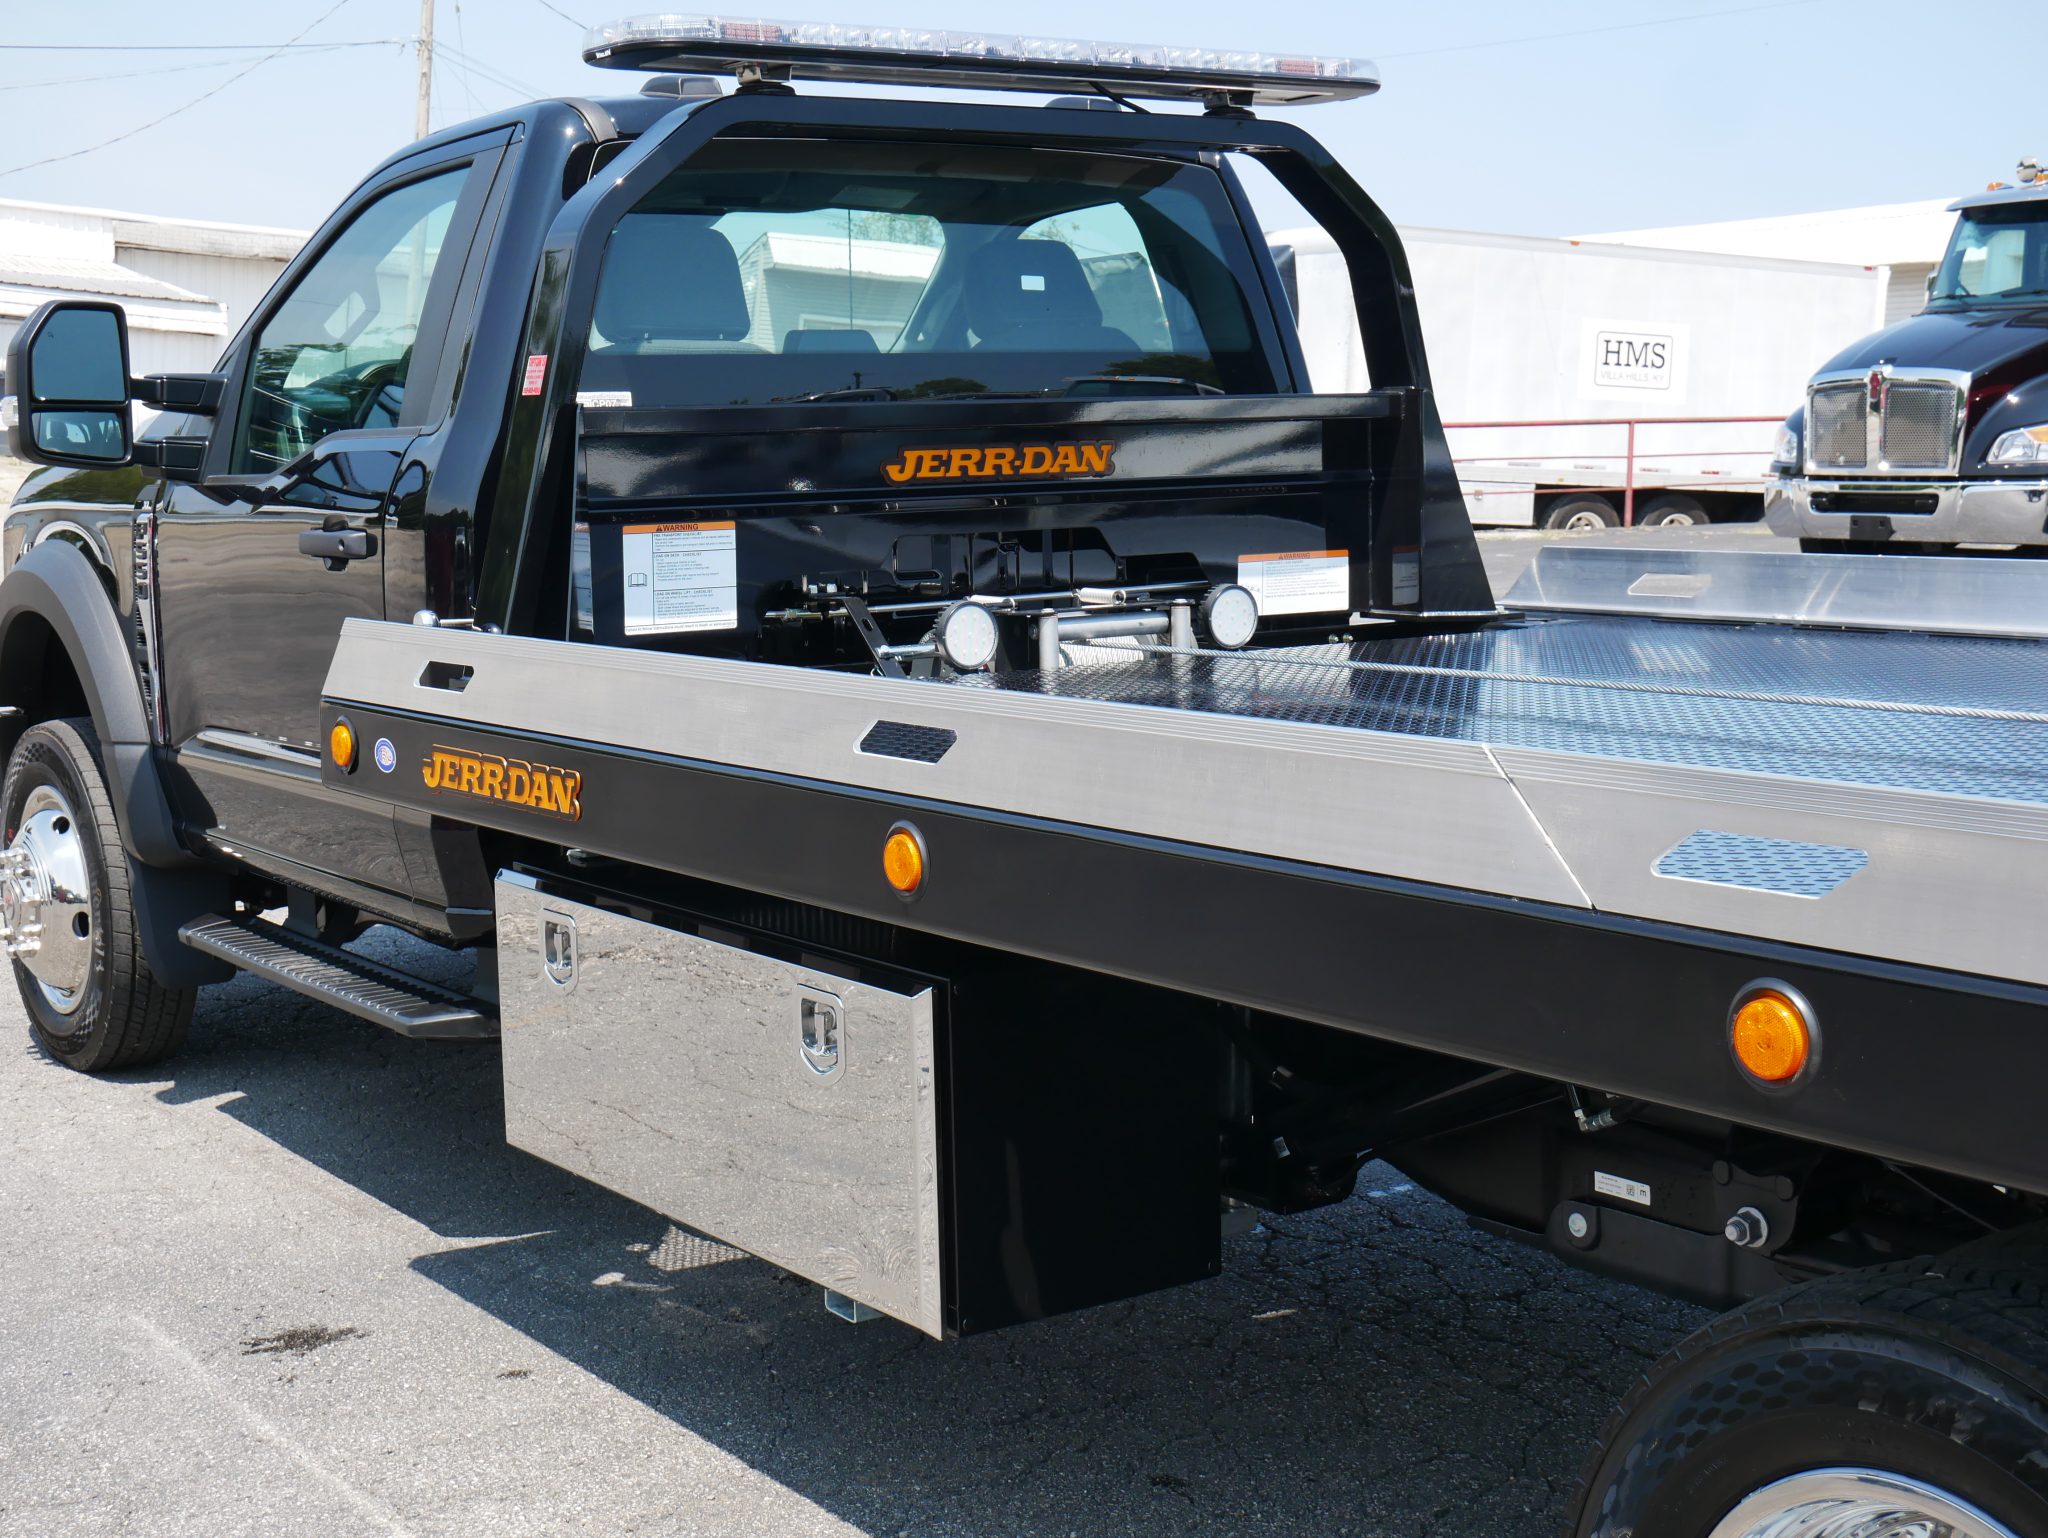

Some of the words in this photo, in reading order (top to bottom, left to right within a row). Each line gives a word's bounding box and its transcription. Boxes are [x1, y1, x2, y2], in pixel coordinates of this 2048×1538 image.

[1602, 339, 1666, 369] HMS
[1600, 370, 1624, 380] VILLA
[1626, 372, 1649, 382] HILLS
[885, 443, 1114, 482] JERR-DAN
[662, 523, 699, 532] WARNING
[1283, 552, 1311, 561] WARNING
[422, 749, 577, 816] JERR-DAN
